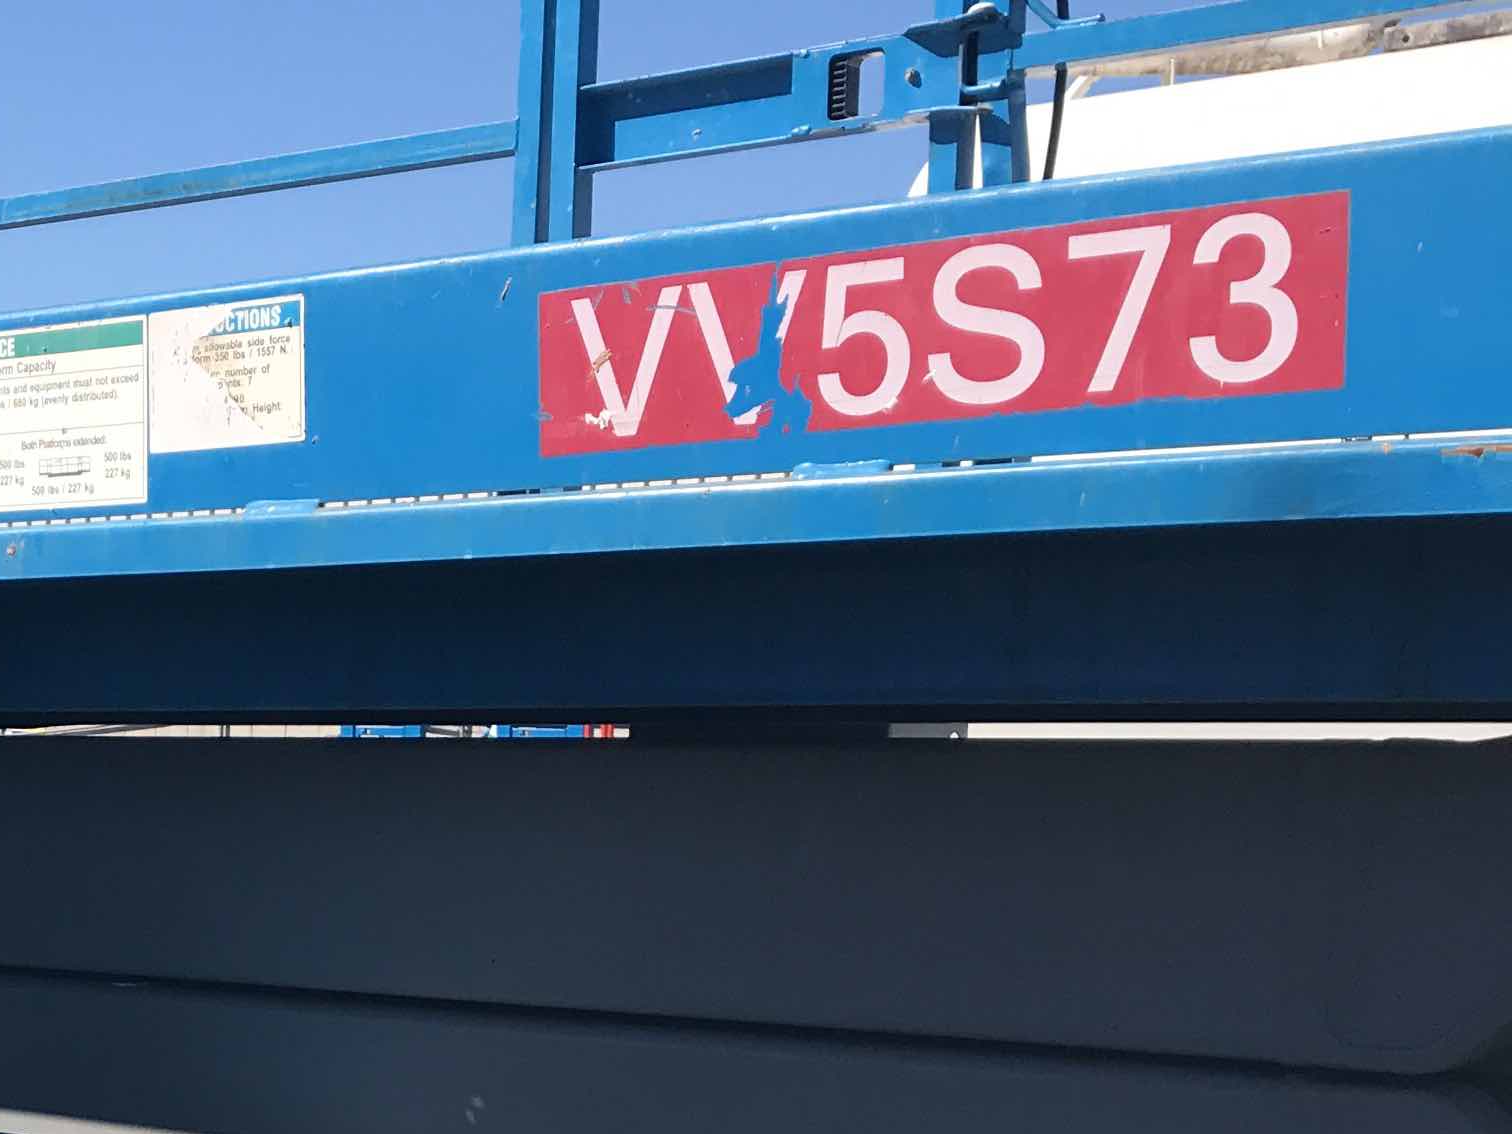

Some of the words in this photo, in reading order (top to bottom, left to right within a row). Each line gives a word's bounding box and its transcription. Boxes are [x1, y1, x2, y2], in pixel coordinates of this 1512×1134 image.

[248, 336, 265, 347] side
[269, 334, 291, 344] force
[17, 358, 57, 375] Capacity
[224, 367, 257, 378] number
[261, 363, 270, 374] of
[13, 383, 28, 394] and
[30, 379, 70, 393] equipment
[96, 374, 109, 384] not
[111, 372, 139, 384] exceed
[252, 400, 281, 414] Height
